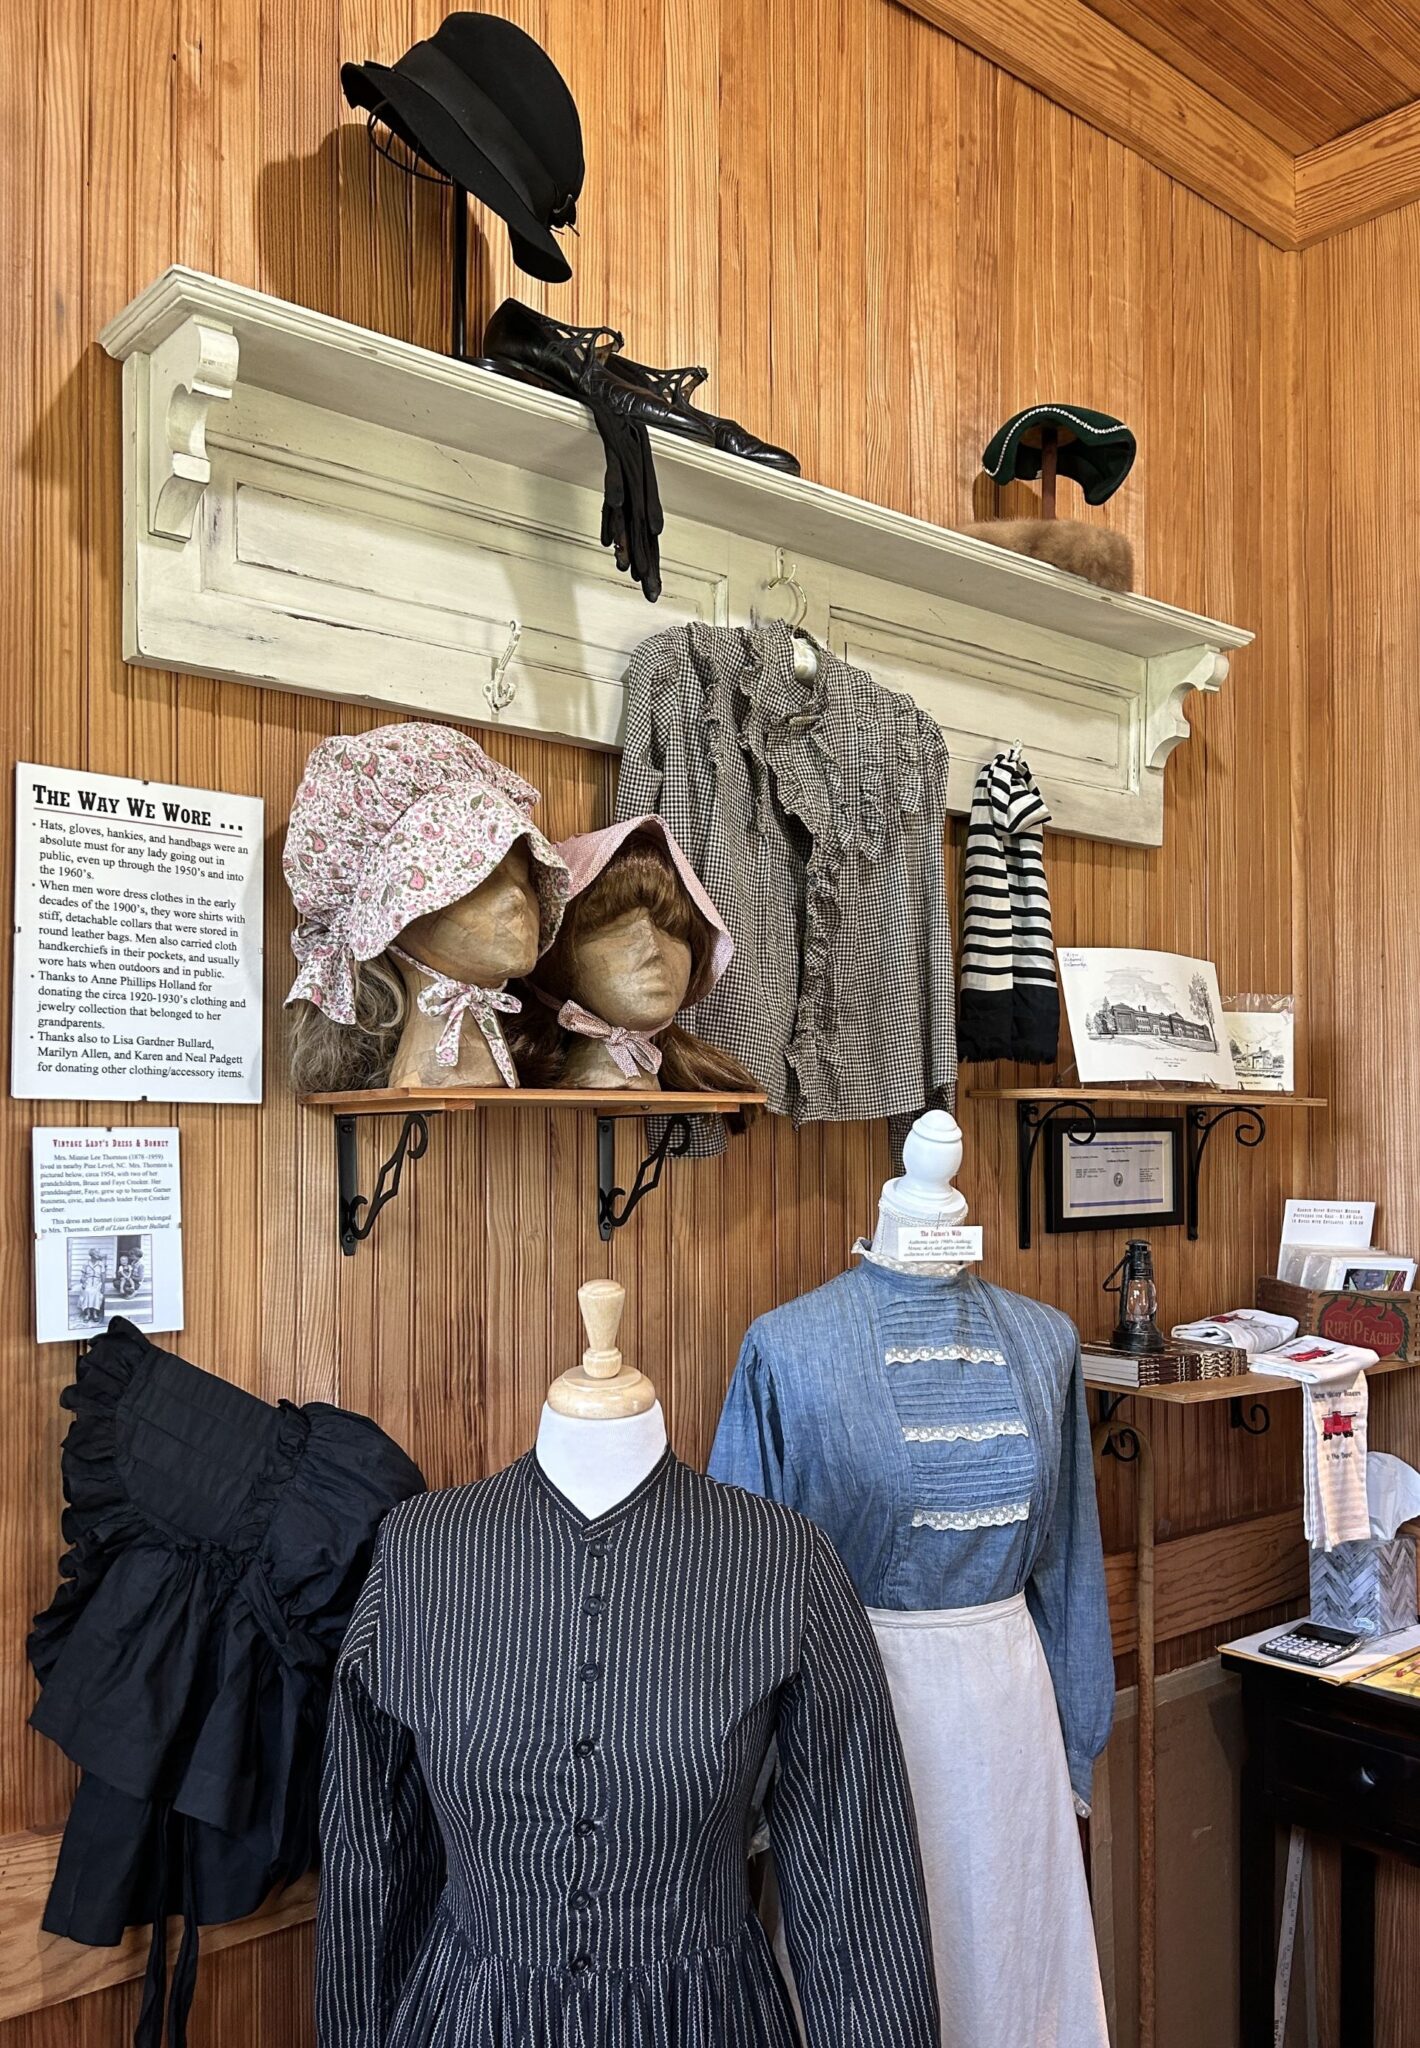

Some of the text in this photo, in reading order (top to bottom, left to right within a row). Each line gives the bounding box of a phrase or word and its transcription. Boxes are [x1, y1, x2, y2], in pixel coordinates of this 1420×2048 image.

[32, 784, 70, 808] THE
[77, 790, 120, 814] WAY
[126, 797, 155, 819] WE
[162, 802, 211, 827] WORE
[40, 819, 66, 833] Hats,
[69, 823, 104, 837] gloves,
[107, 827, 146, 843] hankies,
[149, 835, 166, 844] and
[168, 835, 211, 851] handbags
[213, 844, 235, 852] were
[40, 834, 225, 865] absolute must for any lady going out in
[39, 850, 74, 864] public,
[77, 856, 100, 865] even
[103, 859, 115, 869] up
[118, 859, 155, 873] through
[157, 863, 171, 873] the
[208, 870, 224, 879] and
[227, 871, 244, 881] into
[40, 865, 55, 875] the
[40, 879, 236, 911] When men wore dress clothes in the early
[39, 894, 79, 907] decades
[82, 898, 93, 909] of
[95, 900, 110, 911] the
[151, 906, 171, 919] they
[173, 911, 196, 919] wore
[199, 911, 223, 921] shirts
[226, 914, 245, 924] with
[39, 910, 238, 937] stiff, detachable collars that were stored in
[39, 927, 237, 951] round leather bags. Men also carried cloth
[38, 940, 240, 967] handkerchiefs in their pockets, and usually
[38, 957, 224, 979] wore hats when outdoors and in public.
[38, 970, 212, 991] Thanks to Anne Phillips Holland for
[38, 986, 82, 1000] donating
[85, 989, 100, 999] the
[102, 990, 127, 1000] circa
[190, 996, 227, 1009] clothing
[230, 999, 246, 1008] and
[36, 1001, 75, 1014] jewelry
[79, 1004, 126, 1015] collection
[130, 1006, 147, 1016] that
[150, 1007, 192, 1020] belonged
[206, 1011, 221, 1020] her
[38, 1017, 104, 1029] grandparents.
[37, 1031, 214, 1050] Thanks also to Lisa Gardner Bullard,
[37, 1047, 243, 1066] Marilyn Allen, and Karen and Neal Padgett
[37, 1061, 244, 1079] for donating other clothing/accessory items.
[1354, 1319, 1400, 1345] PEACHES
